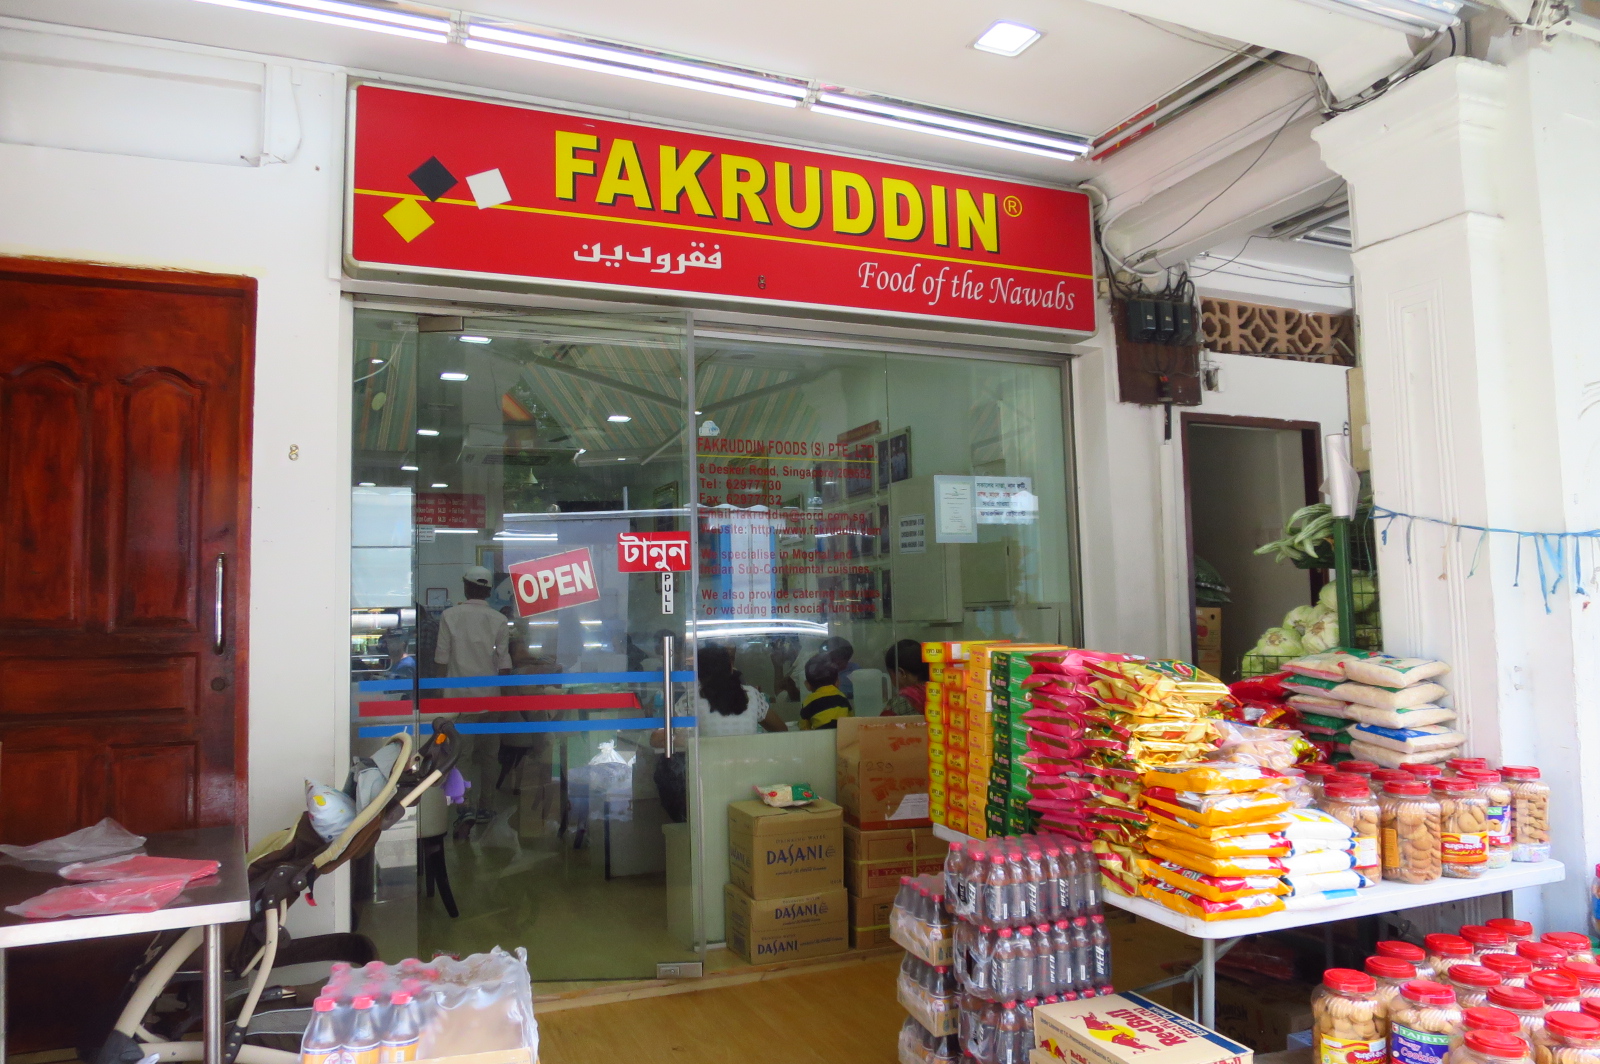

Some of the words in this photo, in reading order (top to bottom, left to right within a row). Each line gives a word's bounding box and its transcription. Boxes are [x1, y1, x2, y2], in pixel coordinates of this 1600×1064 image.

[555, 129, 999, 253] FAKRUDDIN
[757, 274, 766, 290] 8
[858, 261, 922, 294] Food
[922, 266, 950, 306] of
[951, 269, 984, 300] the
[988, 277, 1075, 311] Nawabs
[288, 443, 300, 461] 8
[697, 437, 765, 454] FAKRUDDIN
[768, 440, 807, 456] FOODS
[810, 441, 825, 457] (S)
[855, 444, 878, 459] LTD.
[698, 463, 705, 474] 8
[708, 463, 746, 475] Desker
[749, 464, 779, 478] Road,
[782, 465, 834, 480] Singapore
[726, 478, 782, 491] 62977730
[726, 493, 783, 506] 62977732
[700, 523, 747, 535] Website:
[618, 532, 689, 571] টানুন
[701, 548, 718, 560] We
[721, 549, 776, 562] specialise
[779, 549, 789, 559] in
[793, 549, 830, 562] Moghal
[833, 549, 853, 560] and
[700, 563, 734, 575] Indian
[738, 563, 824, 575] Sub-Continental
[517, 560, 595, 604] OPEN
[701, 589, 719, 600] We
[722, 588, 745, 600] also
[749, 588, 789, 602] provide
[792, 589, 835, 603] catering
[838, 589, 881, 599] services
[721, 603, 767, 617] wedding
[771, 603, 791, 614] and
[793, 603, 825, 614] social
[766, 844, 823, 867] DASANI
[775, 903, 817, 920] DASANI
[757, 939, 798, 956] DASANI
[1096, 945, 1105, 975] SPEED
[1105, 1008, 1150, 1029] Bull
[1148, 1006, 1176, 1021] Drink
[1137, 1023, 1187, 1047] Red
[1173, 1019, 1209, 1037] Energy
